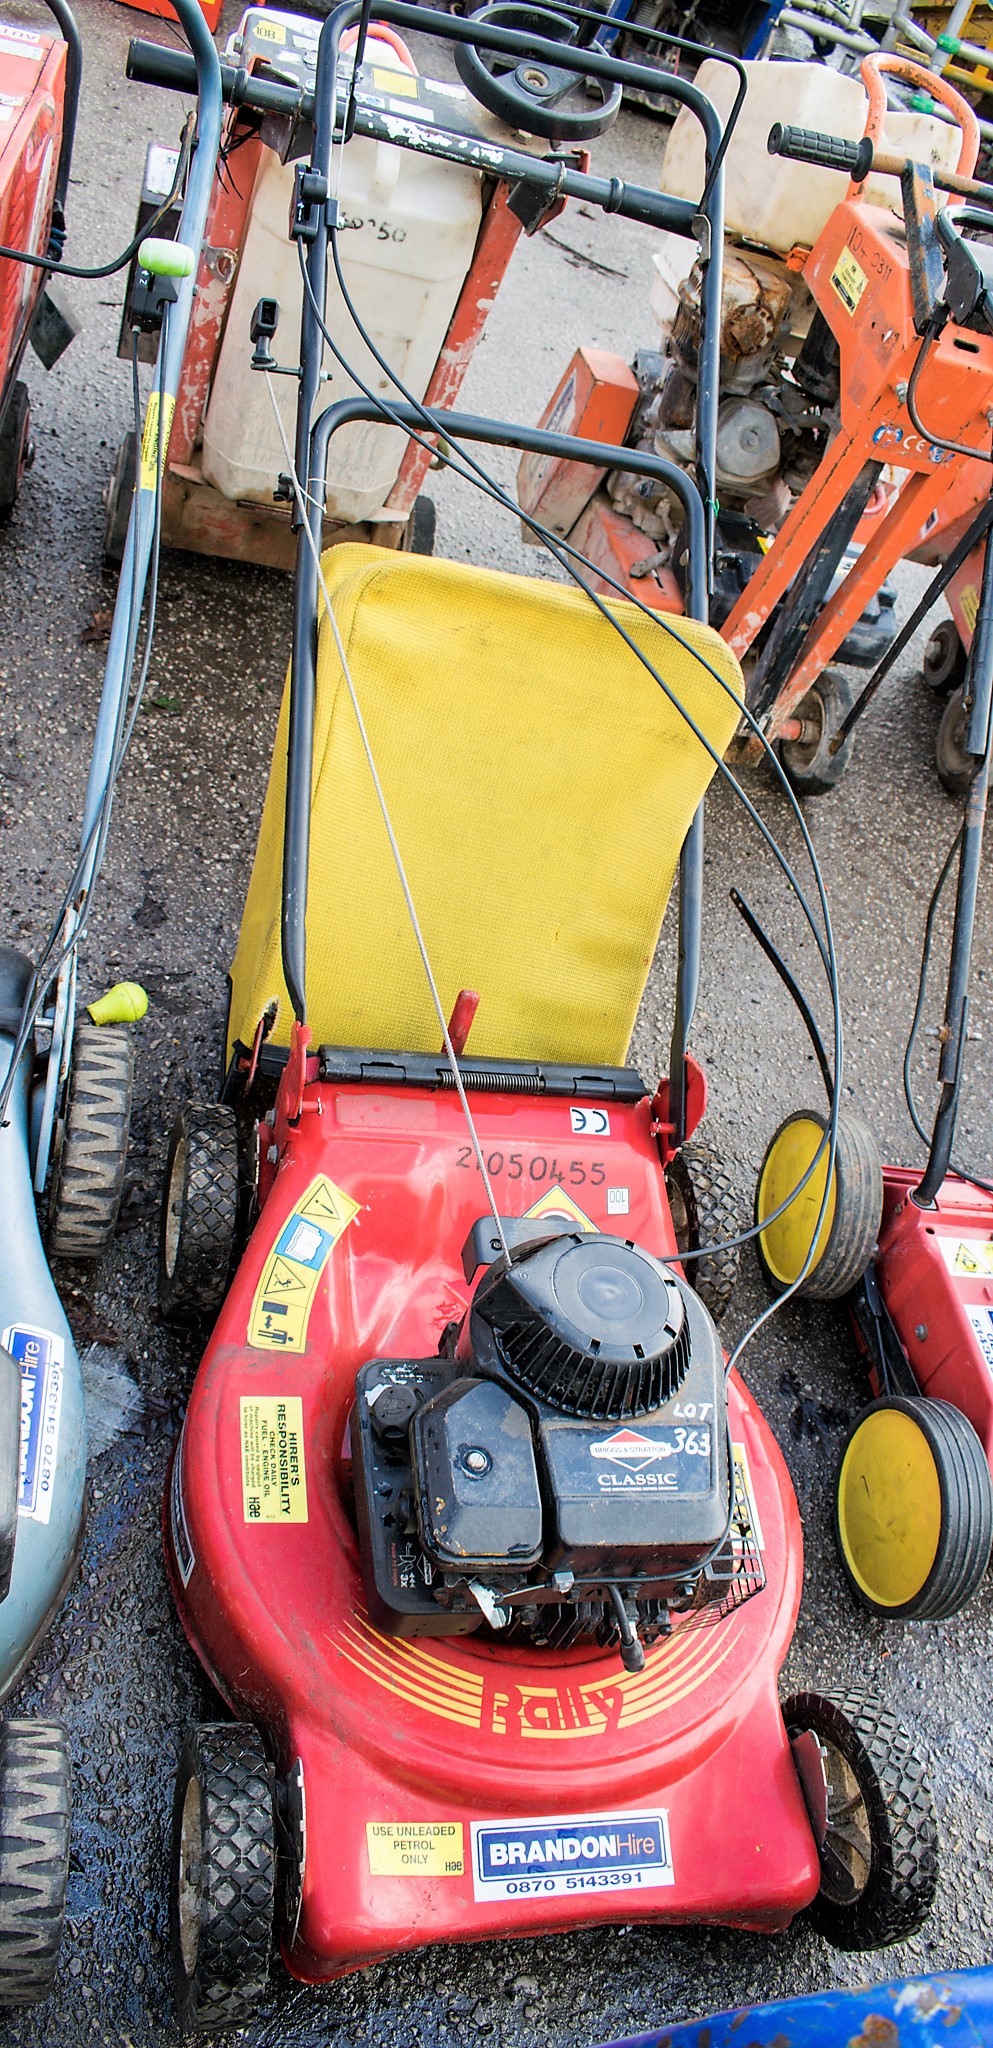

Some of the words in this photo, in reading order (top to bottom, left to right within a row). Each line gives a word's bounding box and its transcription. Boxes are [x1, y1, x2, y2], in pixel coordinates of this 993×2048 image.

[255, 25, 276, 40] 108
[609, 1190, 626, 1204] 100
[673, 1402, 713, 1421] LOT
[670, 1427, 710, 1457] 363
[41, 1444, 53, 1492] 0870
[262, 1450, 270, 1481] ENGINE
[278, 1404, 291, 1515] RESPONSIBILITY
[289, 1433, 300, 1486] HIRER'S
[597, 1473, 678, 1486] CLASSIC
[480, 1679, 624, 1734] Rally
[372, 1826, 394, 1837] USE
[397, 1826, 456, 1837] UNLEADED
[393, 1840, 435, 1850] PETROL
[401, 1854, 428, 1865] ONLY
[506, 1880, 556, 1894] 0870
[566, 1872, 643, 1889] 5143391
